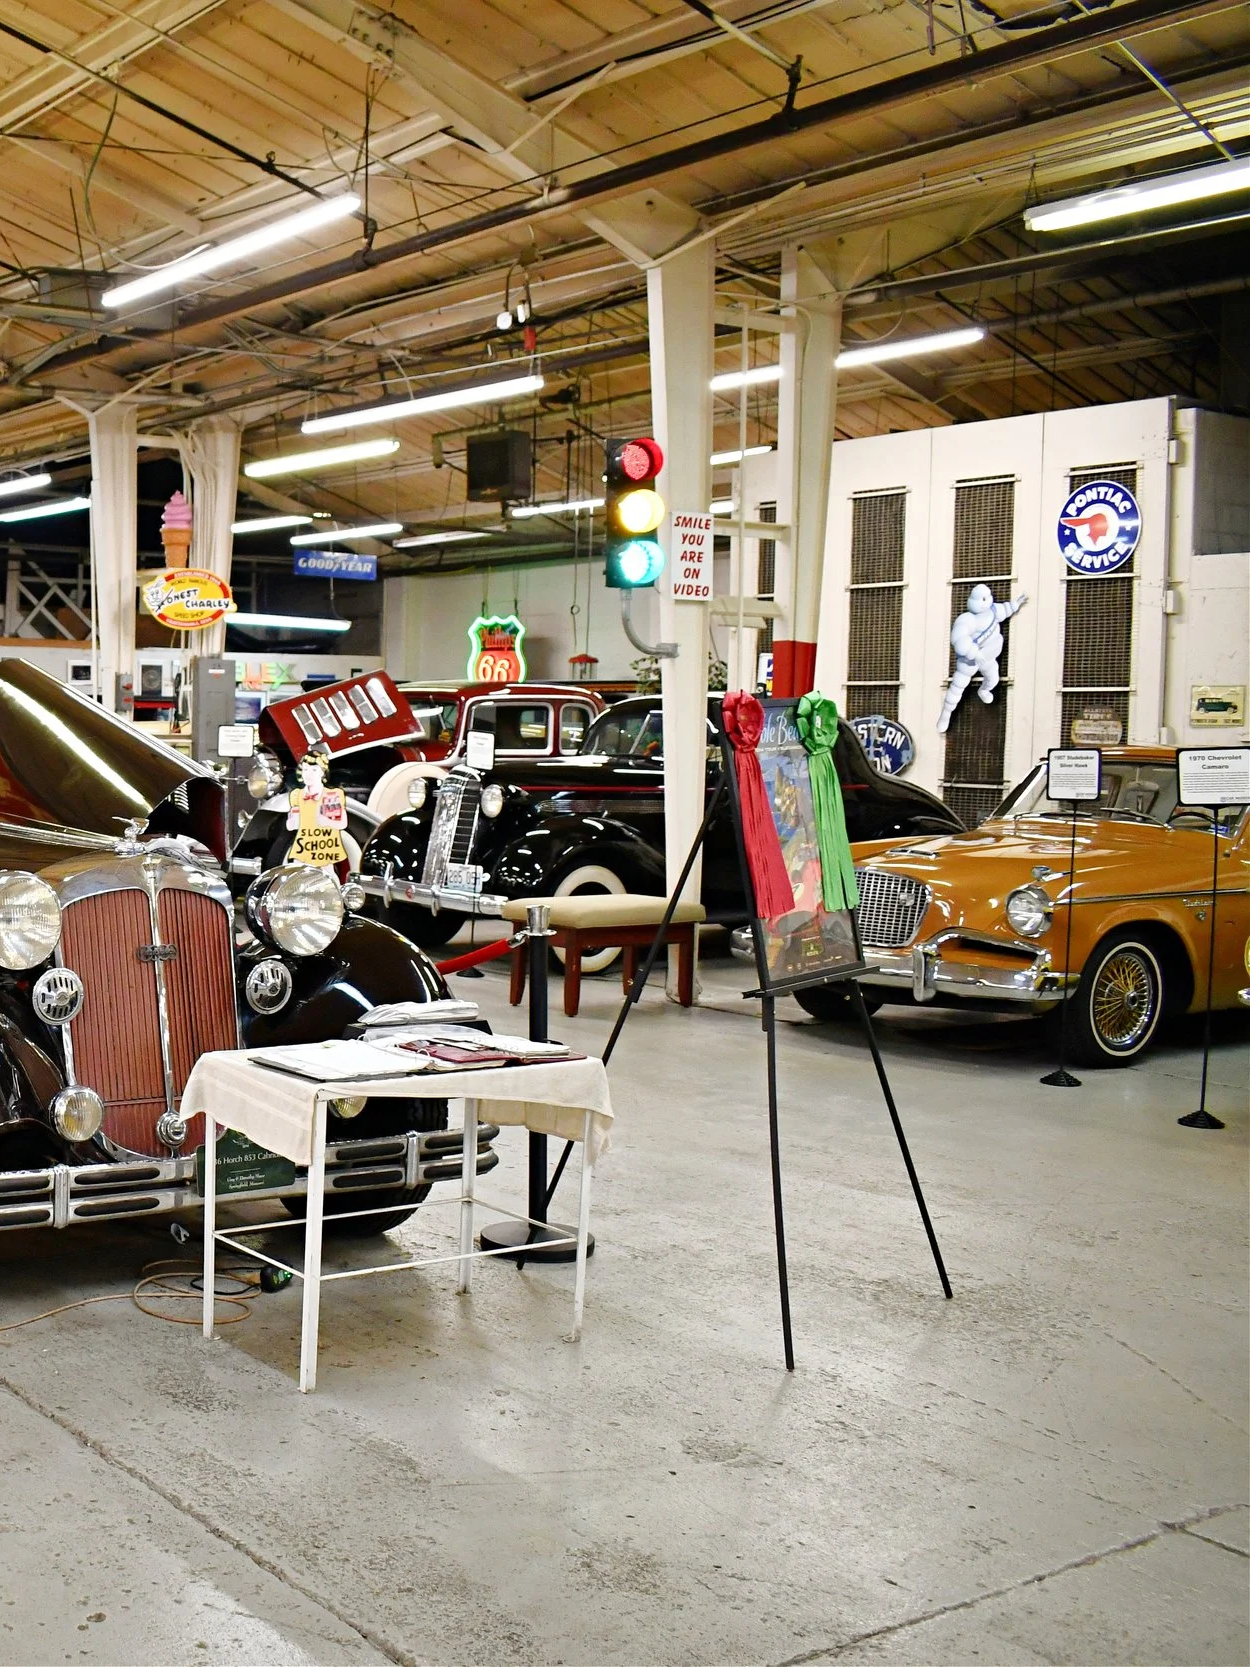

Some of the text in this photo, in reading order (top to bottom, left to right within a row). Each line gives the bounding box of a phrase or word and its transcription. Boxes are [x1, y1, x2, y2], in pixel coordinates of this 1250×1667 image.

[1065, 486, 1132, 517] PONTIAC
[674, 516, 712, 530] SMILE
[681, 533, 704, 546] YOU
[680, 550, 704, 563] ARE
[1064, 540, 1129, 569] SERVICE
[298, 556, 373, 573] GOODYEAR
[683, 567, 701, 579] ON
[673, 583, 710, 597] VIDEO
[185, 599, 230, 608] CHARLEY
[478, 655, 510, 683] 66
[301, 828, 333, 837] SLOW
[296, 837, 340, 854] SCHOOL
[311, 852, 340, 861] ZONE
[223, 1155, 243, 1164] Horch
[244, 1153, 256, 1161] 853
